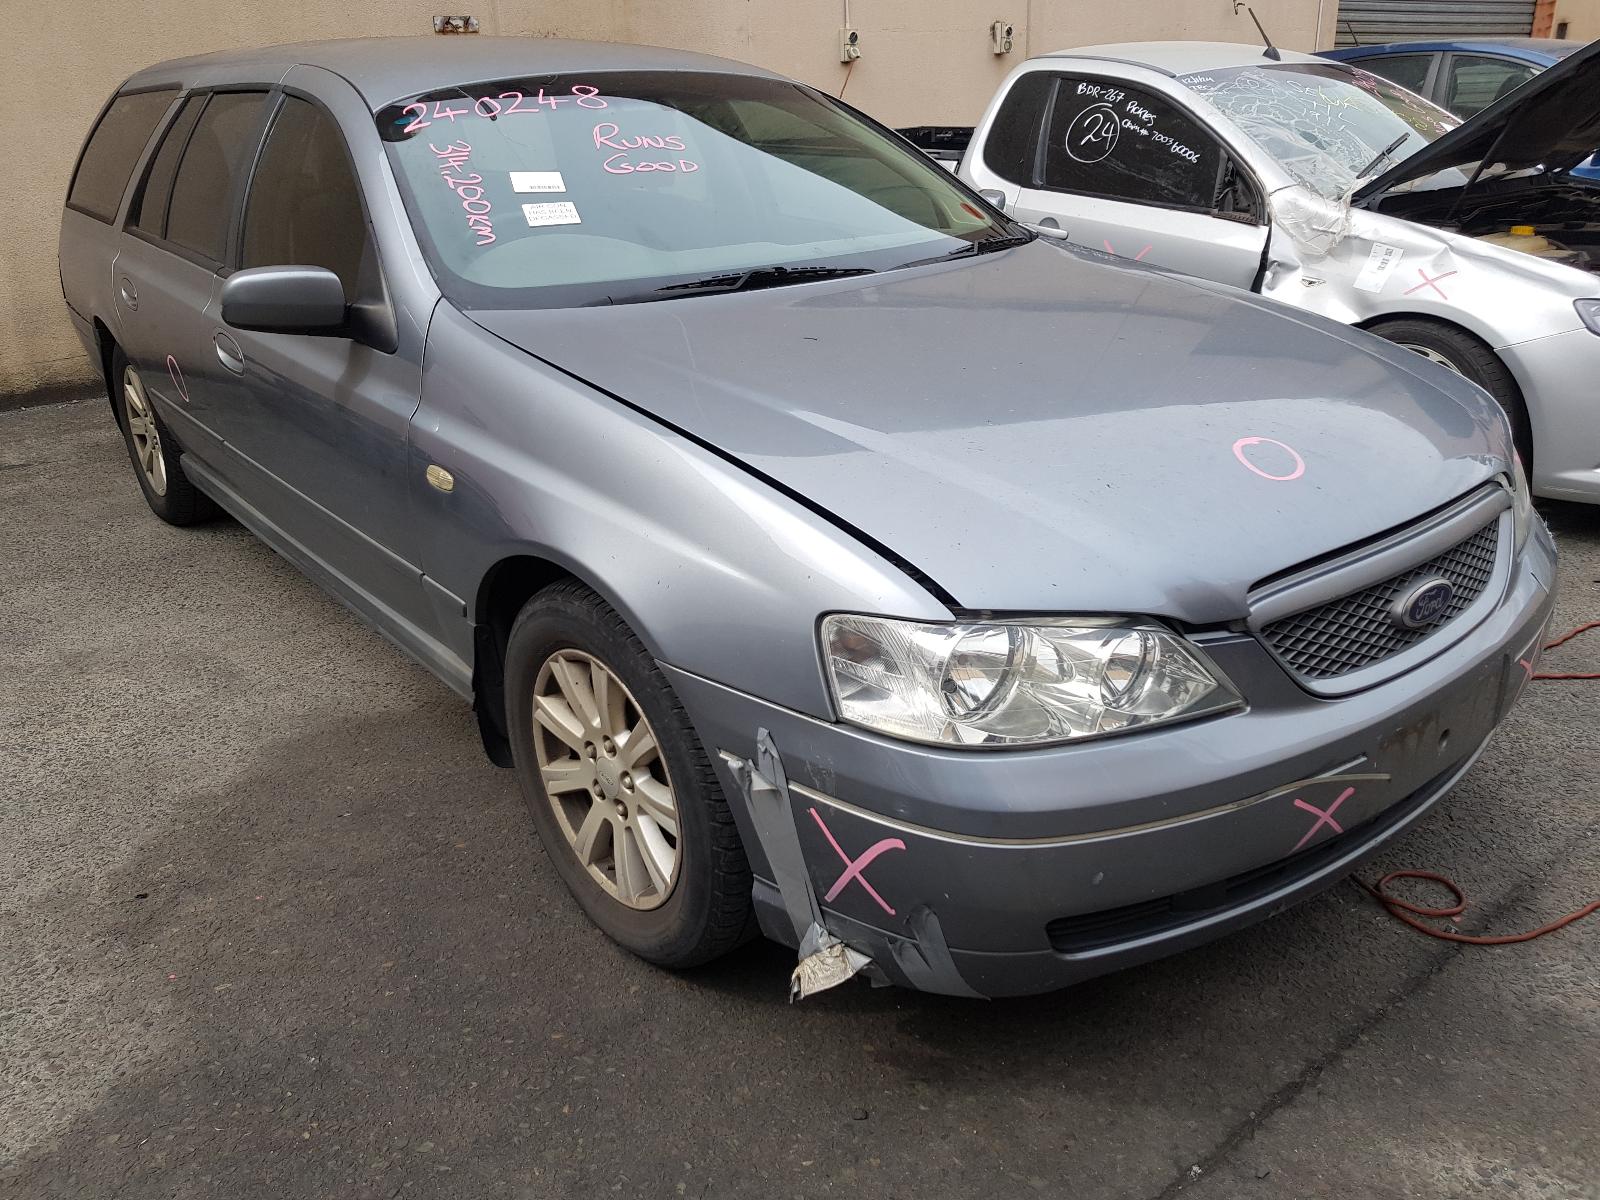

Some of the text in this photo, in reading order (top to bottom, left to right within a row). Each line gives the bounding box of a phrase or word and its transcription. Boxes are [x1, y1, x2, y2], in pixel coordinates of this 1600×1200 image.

[1077, 82, 1125, 101] BDR-267
[1080, 113, 1115, 151] 24
[603, 152, 699, 175] GOOD
[1414, 588, 1445, 620] Ford
